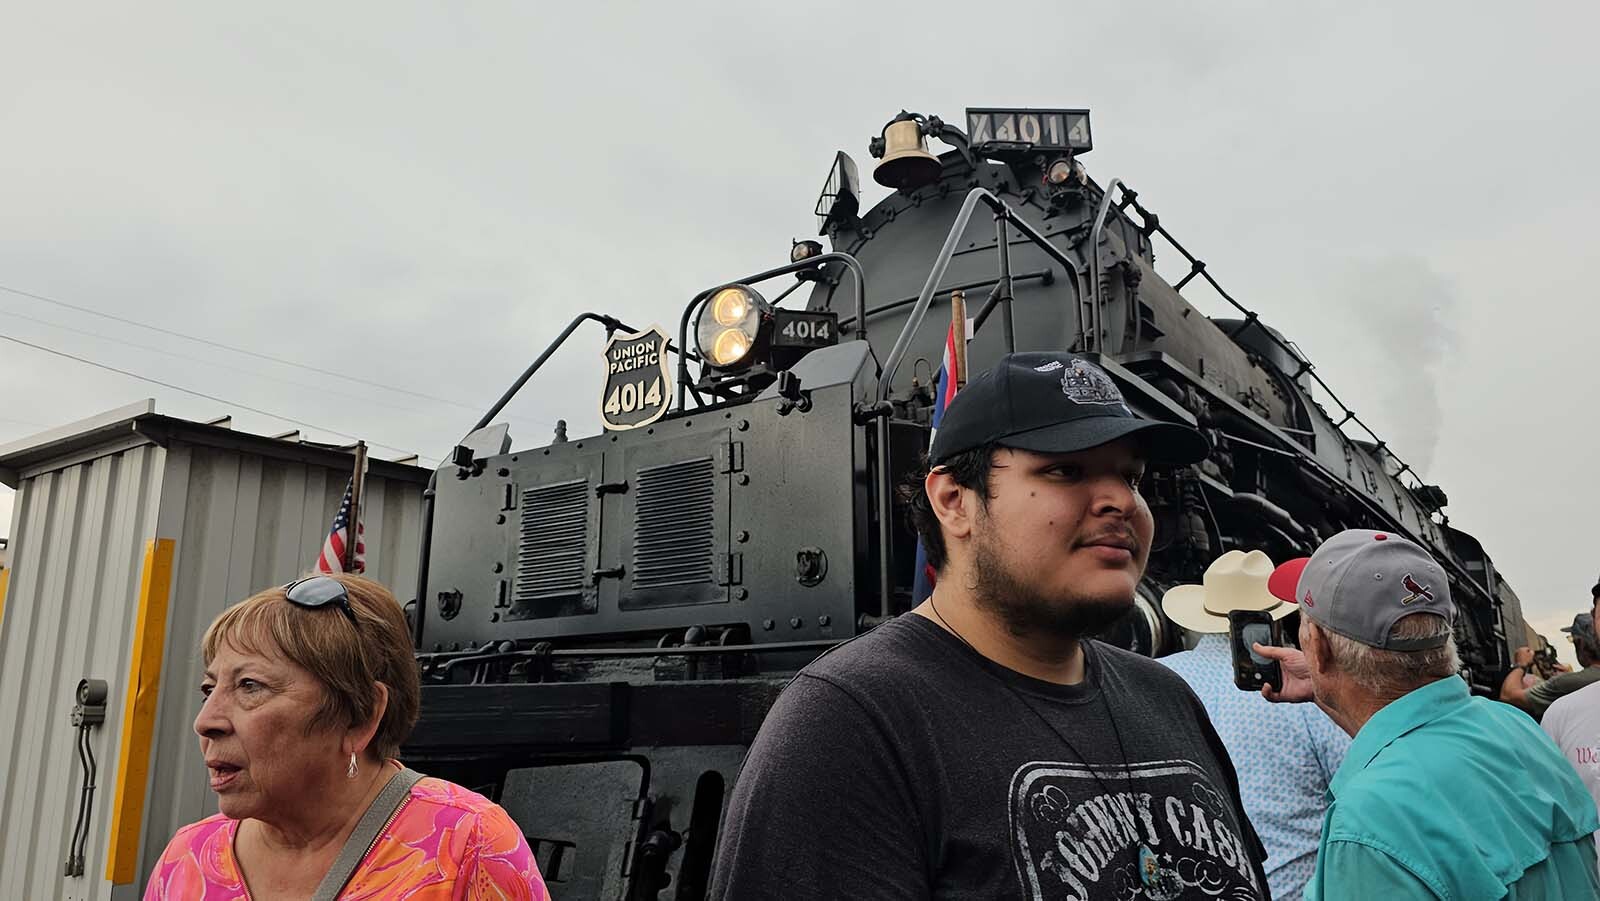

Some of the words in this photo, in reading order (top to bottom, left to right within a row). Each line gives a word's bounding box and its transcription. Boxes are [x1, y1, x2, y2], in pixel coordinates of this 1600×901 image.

[782, 320, 830, 340] 4014
[613, 340, 656, 361] UNION
[610, 352, 659, 375] PACIFIC
[604, 376, 662, 416] 4014
